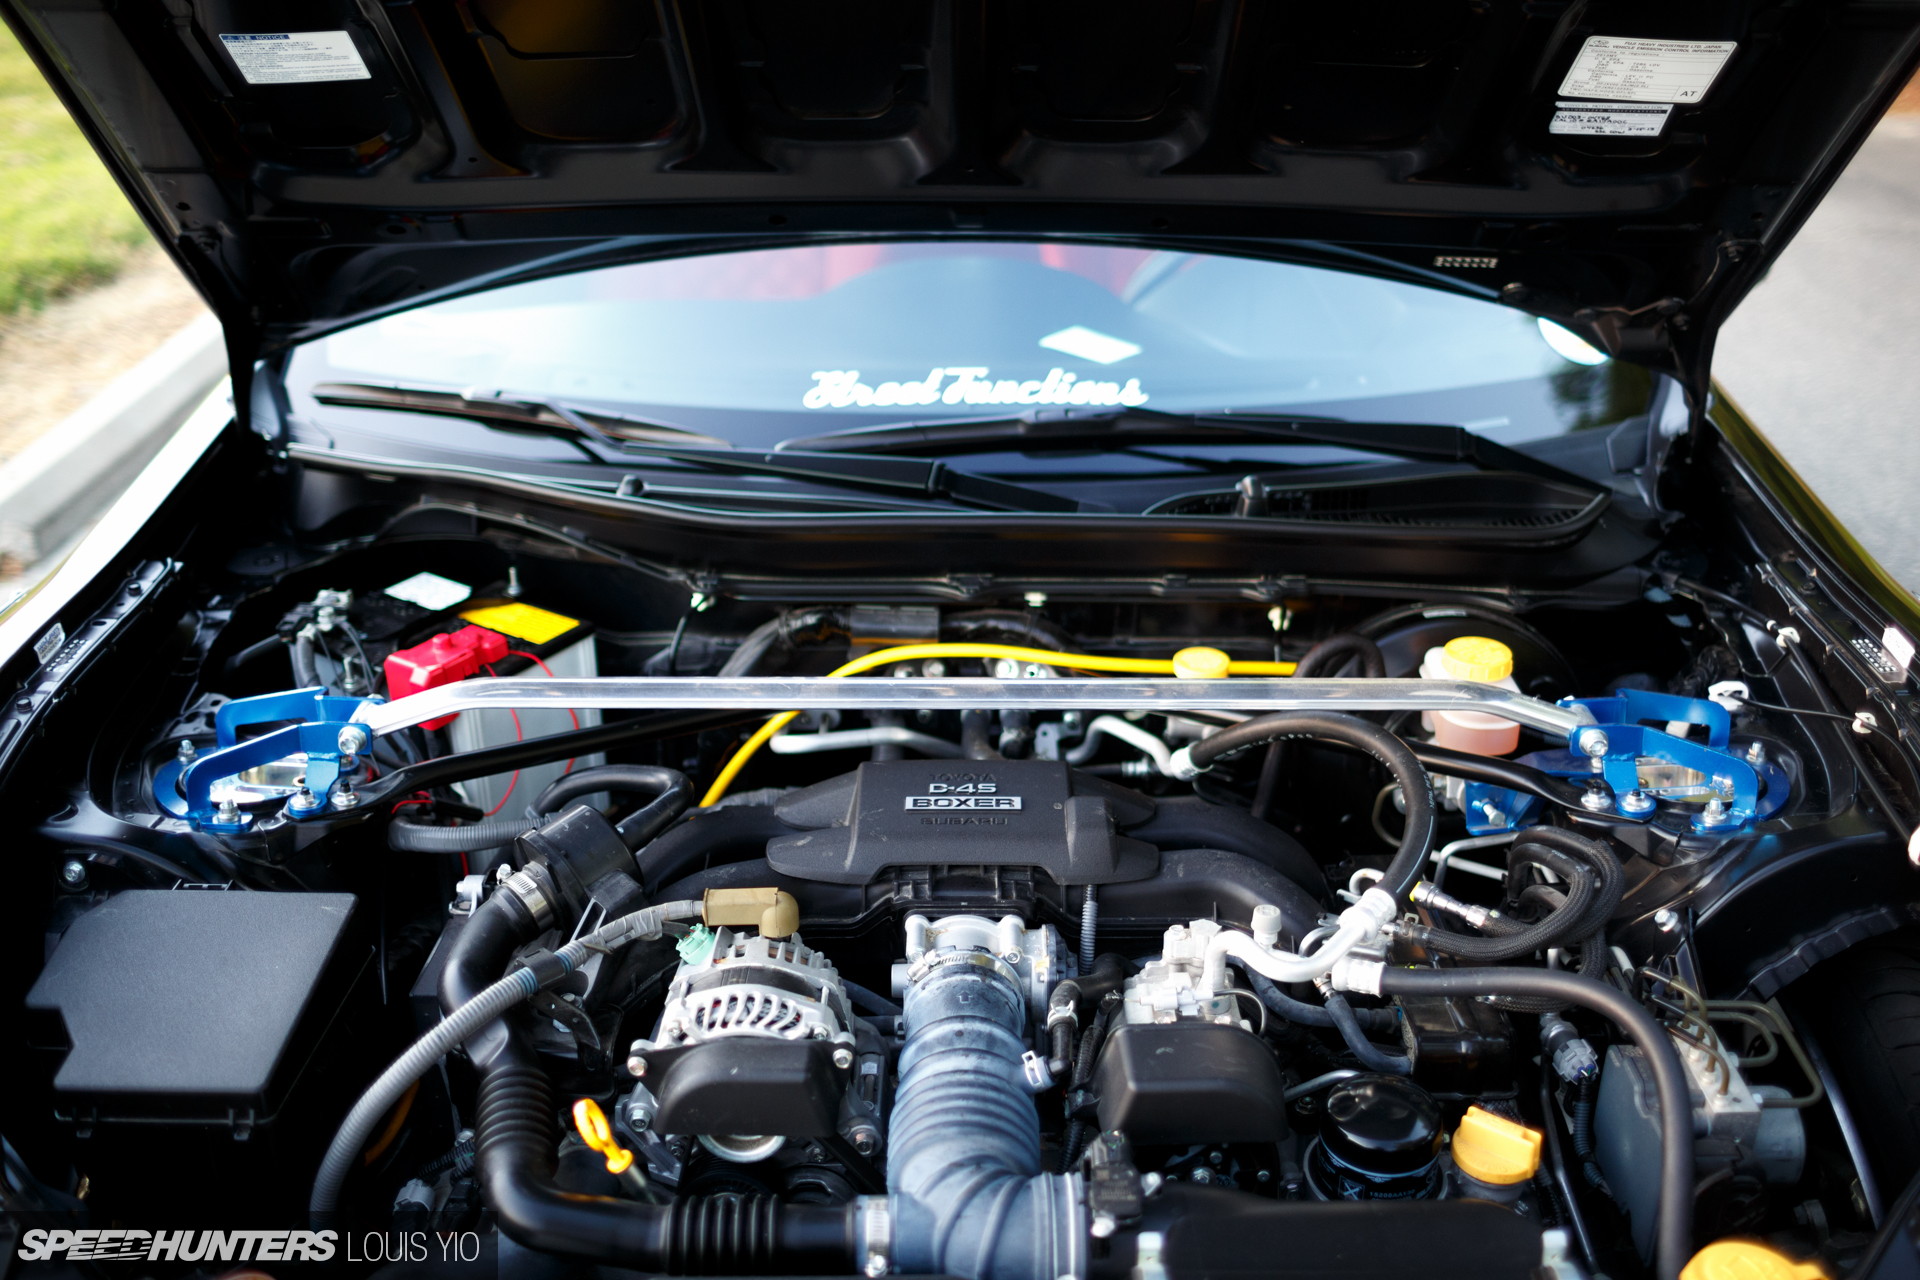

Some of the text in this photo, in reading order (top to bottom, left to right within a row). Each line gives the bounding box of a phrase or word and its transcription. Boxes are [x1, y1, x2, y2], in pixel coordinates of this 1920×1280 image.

[930, 773, 997, 782] TOYOTA
[929, 783, 998, 794] D-4S
[912, 798, 1016, 808] BOXER
[920, 817, 1008, 825] SUBARU
